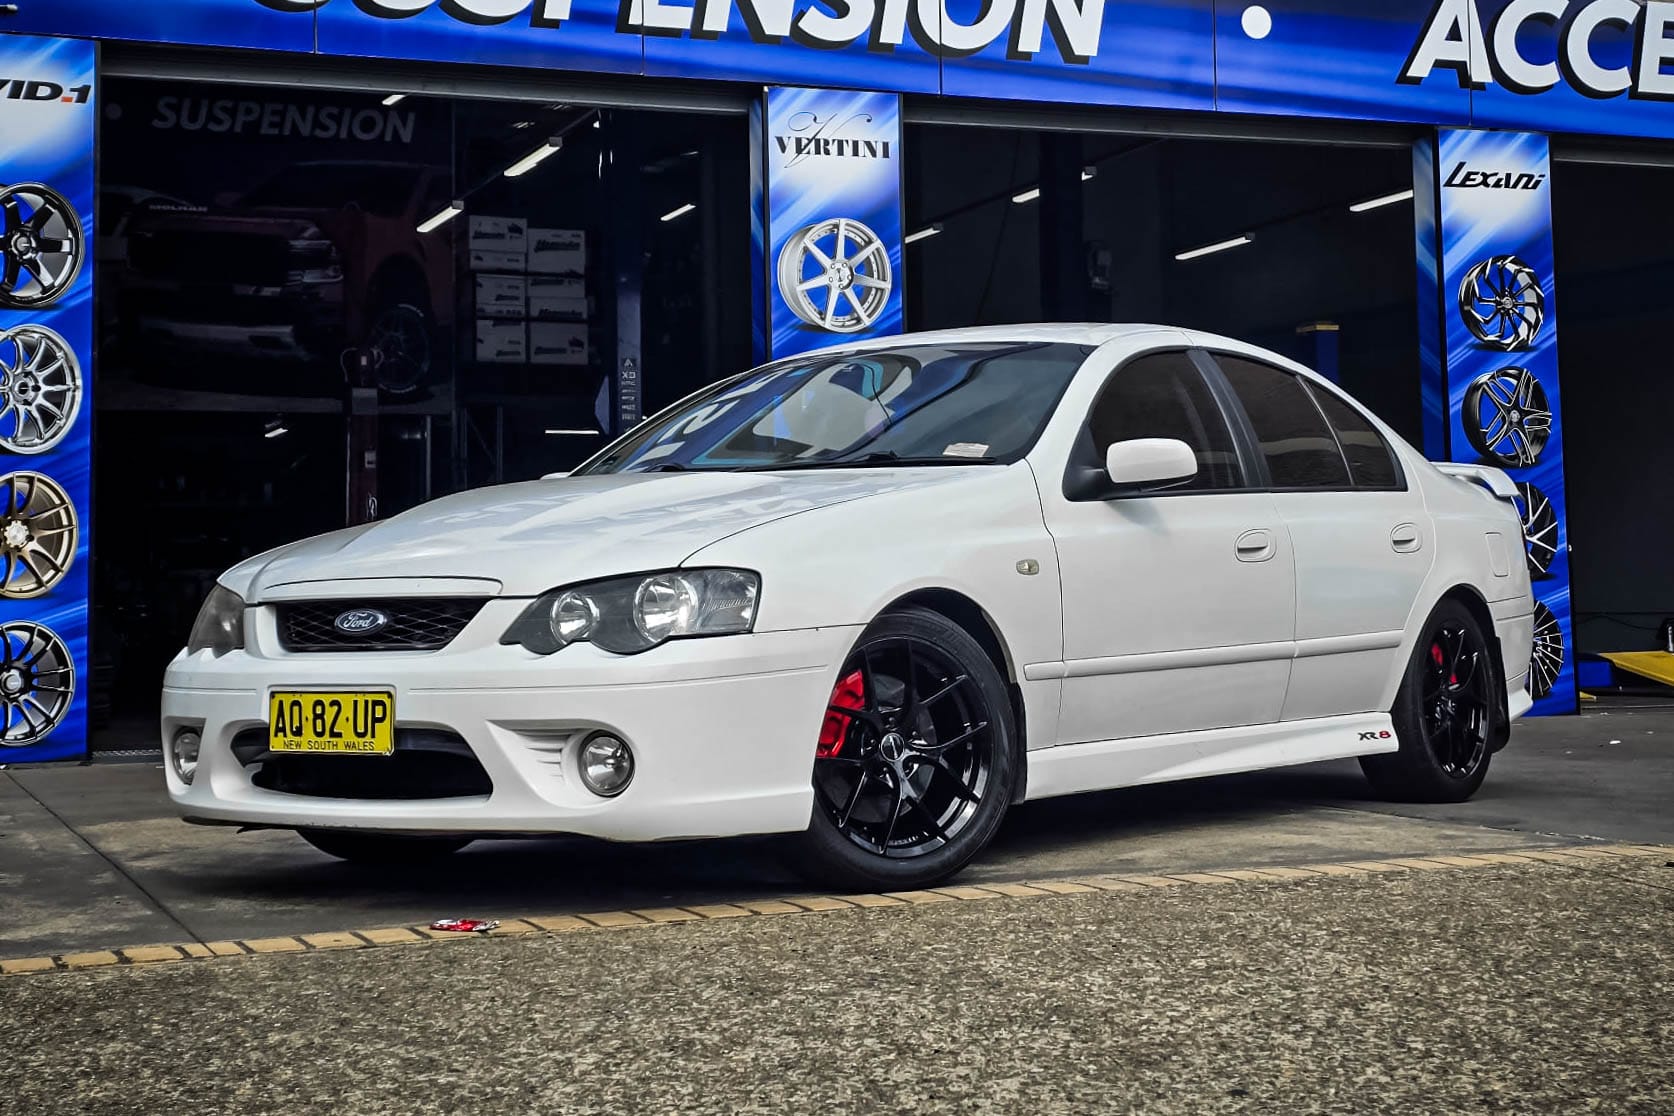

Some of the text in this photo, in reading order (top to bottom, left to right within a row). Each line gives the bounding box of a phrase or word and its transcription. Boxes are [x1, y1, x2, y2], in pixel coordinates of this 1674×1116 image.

[152, 96, 416, 144] SUSPENSION
[775, 136, 890, 159] VERTINI
[343, 612, 373, 628] Ford
[283, 739, 375, 751] NEW SOUTH WALES
